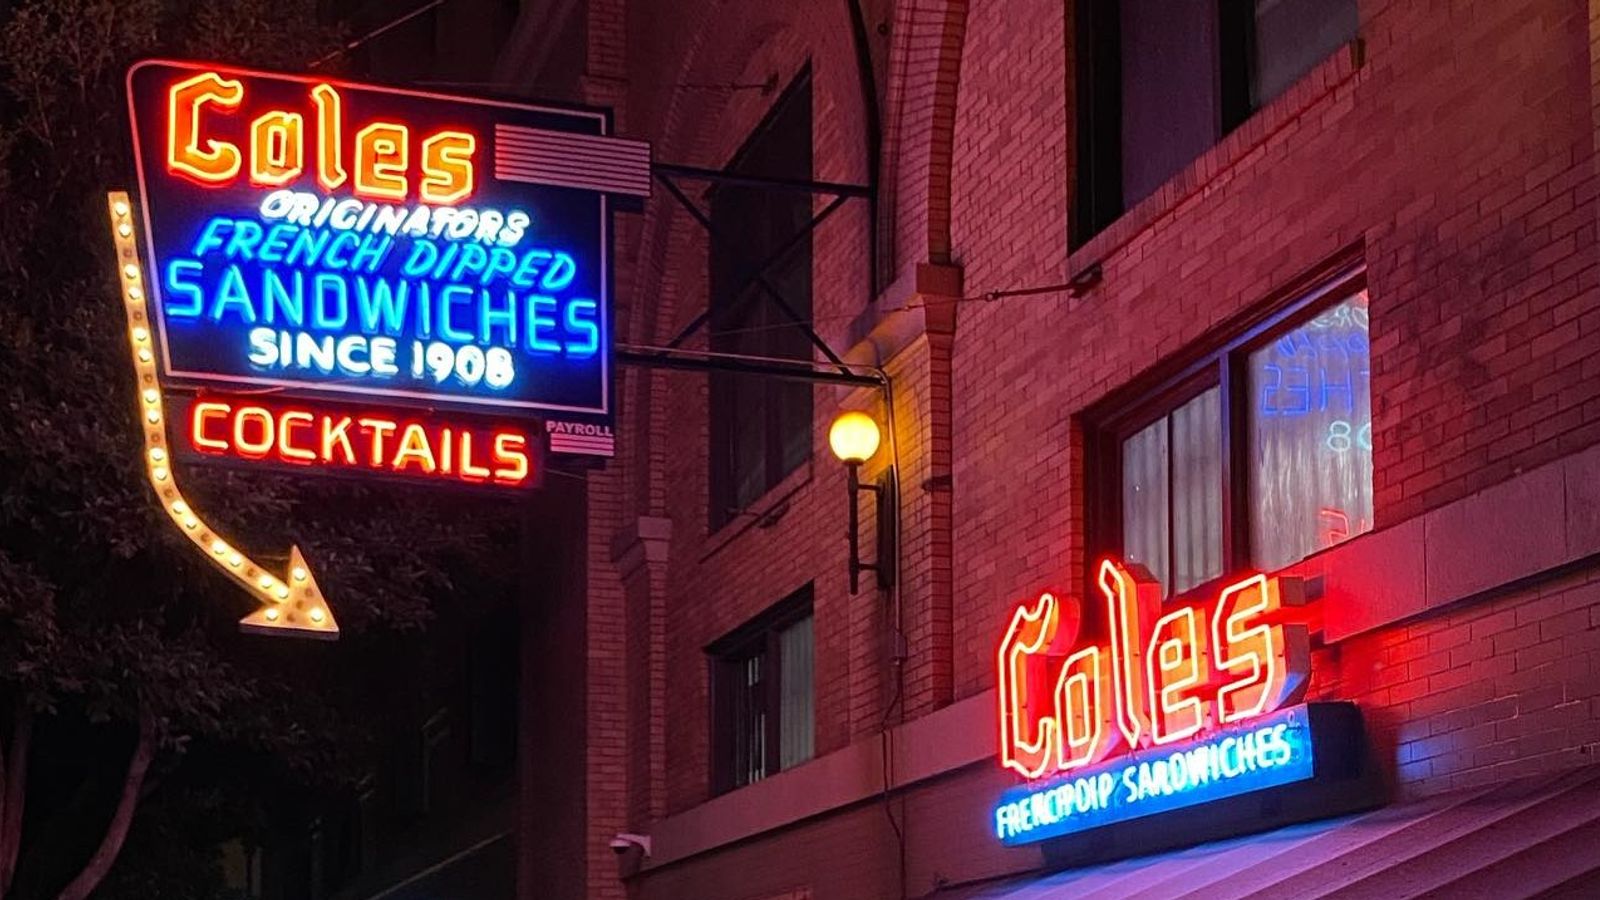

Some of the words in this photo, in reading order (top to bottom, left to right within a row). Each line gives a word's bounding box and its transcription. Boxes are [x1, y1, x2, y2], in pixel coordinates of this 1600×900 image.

[166, 71, 477, 203] Coles
[193, 218, 397, 273] FRENCH
[404, 239, 577, 292] DIPPED
[260, 190, 530, 247] ORIGINATORS
[166, 260, 600, 357] SANDWICHES
[249, 327, 400, 375] SINCE
[412, 339, 515, 390] 1908
[191, 401, 531, 482] COCKTAILS
[545, 420, 614, 437] PAYROLL
[997, 559, 1277, 779] Coles
